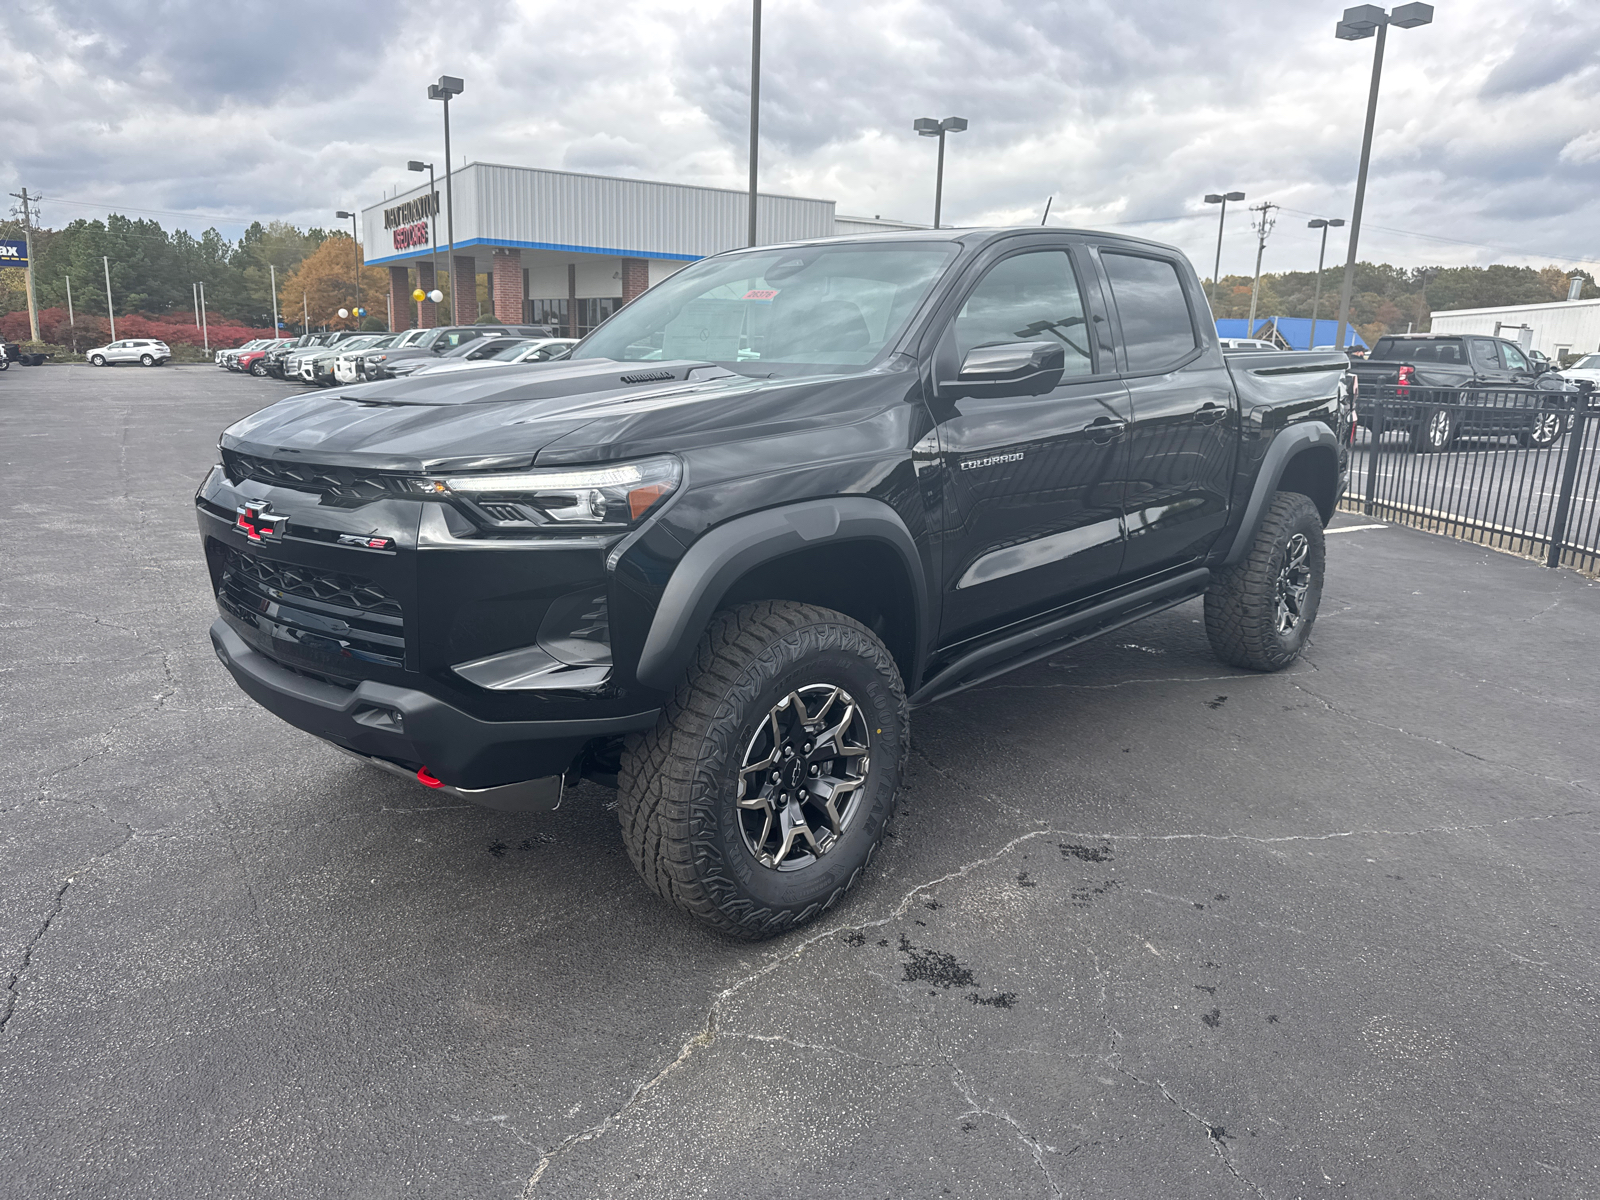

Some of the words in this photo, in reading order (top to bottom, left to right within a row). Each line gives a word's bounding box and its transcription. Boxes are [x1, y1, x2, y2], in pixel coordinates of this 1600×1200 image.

[393, 227, 409, 249] USED
[409, 221, 428, 246] CARS
[960, 452, 1024, 471] COLORADO
[723, 723, 753, 885] WRANGLER
[862, 681, 897, 837] GOODYEAR
